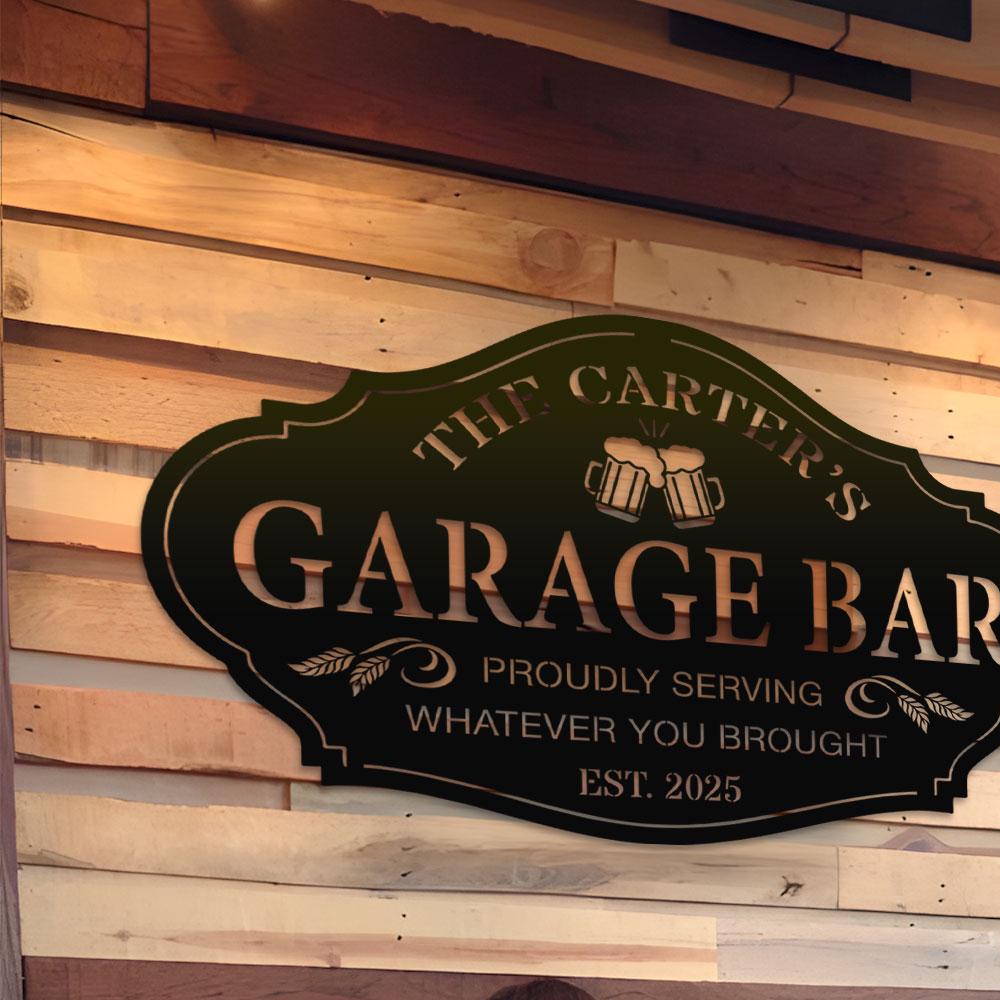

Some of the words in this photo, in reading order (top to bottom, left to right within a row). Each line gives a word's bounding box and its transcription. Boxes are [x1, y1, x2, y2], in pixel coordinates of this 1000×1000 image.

[412, 375, 550, 471] THE
[569, 365, 872, 521] CARTER'S
[233, 499, 772, 649] GARAGE
[482, 656, 660, 695] PROUDLY
[672, 671, 823, 707] SERVING
[405, 703, 617, 744] WHATEVER
[629, 718, 706, 748] YOU
[719, 725, 888, 759] BROUGHT
[579, 768, 654, 799] EST.
[665, 774, 742, 804] 2025
